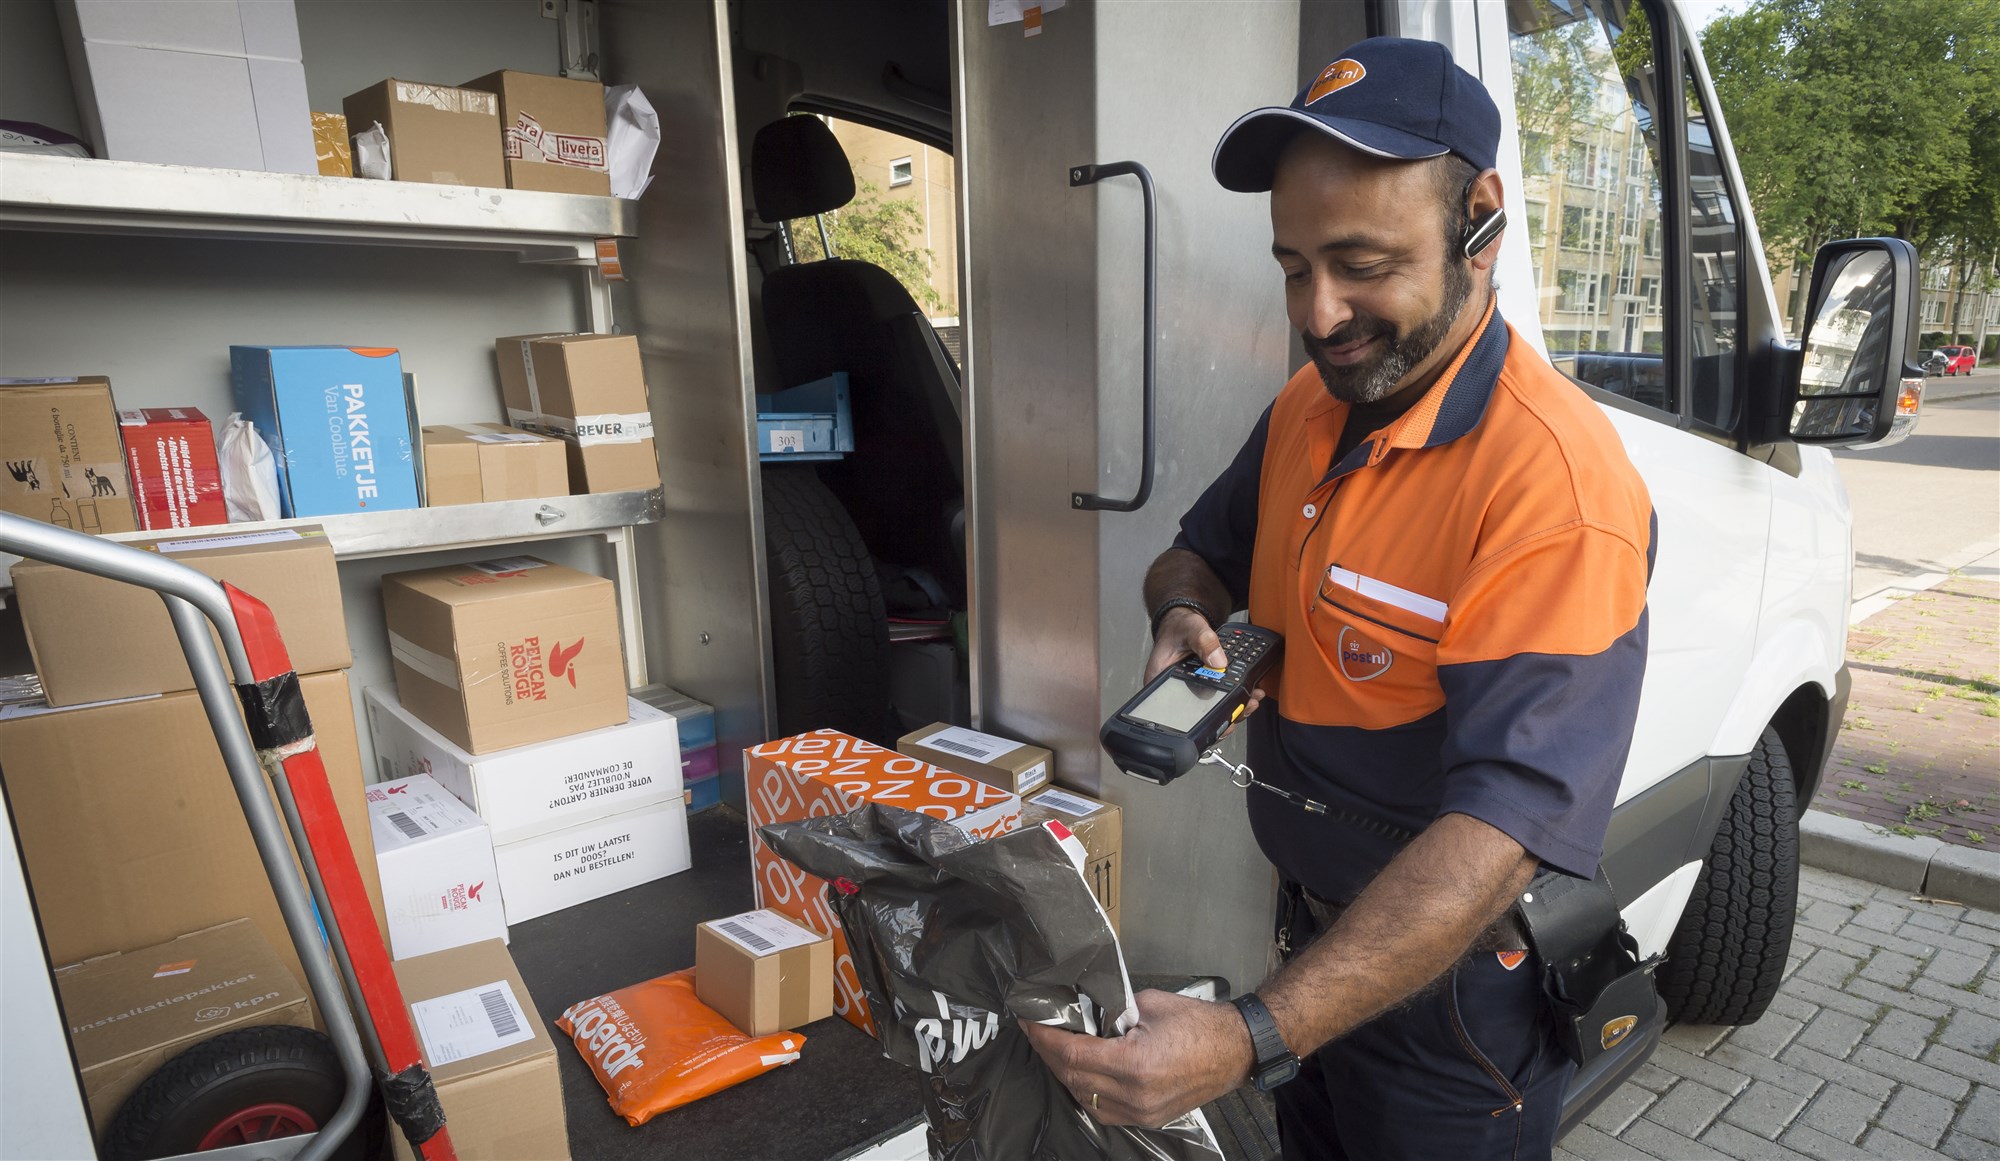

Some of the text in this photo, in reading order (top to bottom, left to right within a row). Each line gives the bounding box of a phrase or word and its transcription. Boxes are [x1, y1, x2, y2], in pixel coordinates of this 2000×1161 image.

[560, 139, 600, 156] livera
[52, 414, 64, 444] bottiglie
[66, 423, 81, 462] CONTIENE
[324, 384, 348, 480] Van Coolblue.
[576, 422, 623, 437] BEVER
[778, 436, 796, 447] 303
[58, 444, 66, 453] da
[61, 455, 70, 468] 750
[157, 440, 169, 471] Grootste
[168, 439, 180, 468] Afhalen
[174, 476, 183, 485] de
[179, 439, 198, 503] Altijd de juiste prijs
[162, 471, 177, 511] assortiment
[176, 485, 188, 508] winkel
[524, 635, 547, 701] PELICAN
[1343, 651, 1385, 665] postnl
[497, 641, 514, 706] COFFEE SOLUTIONS
[510, 644, 532, 701] ROUGE
[564, 760, 633, 785] DE COMMANDER!
[568, 771, 631, 793] N'OUBLIEZ PAS
[549, 775, 653, 809] VOTRE DERNIER CARTON?
[553, 833, 631, 862] IS DIT UW LAATSTE
[580, 850, 607, 864] DOOS?
[553, 851, 635, 881] DAN NU BESTELLEN!
[451, 887, 460, 911] ROUGE
[457, 883, 468, 910] PELICAN
[233, 990, 280, 1010] kpn
